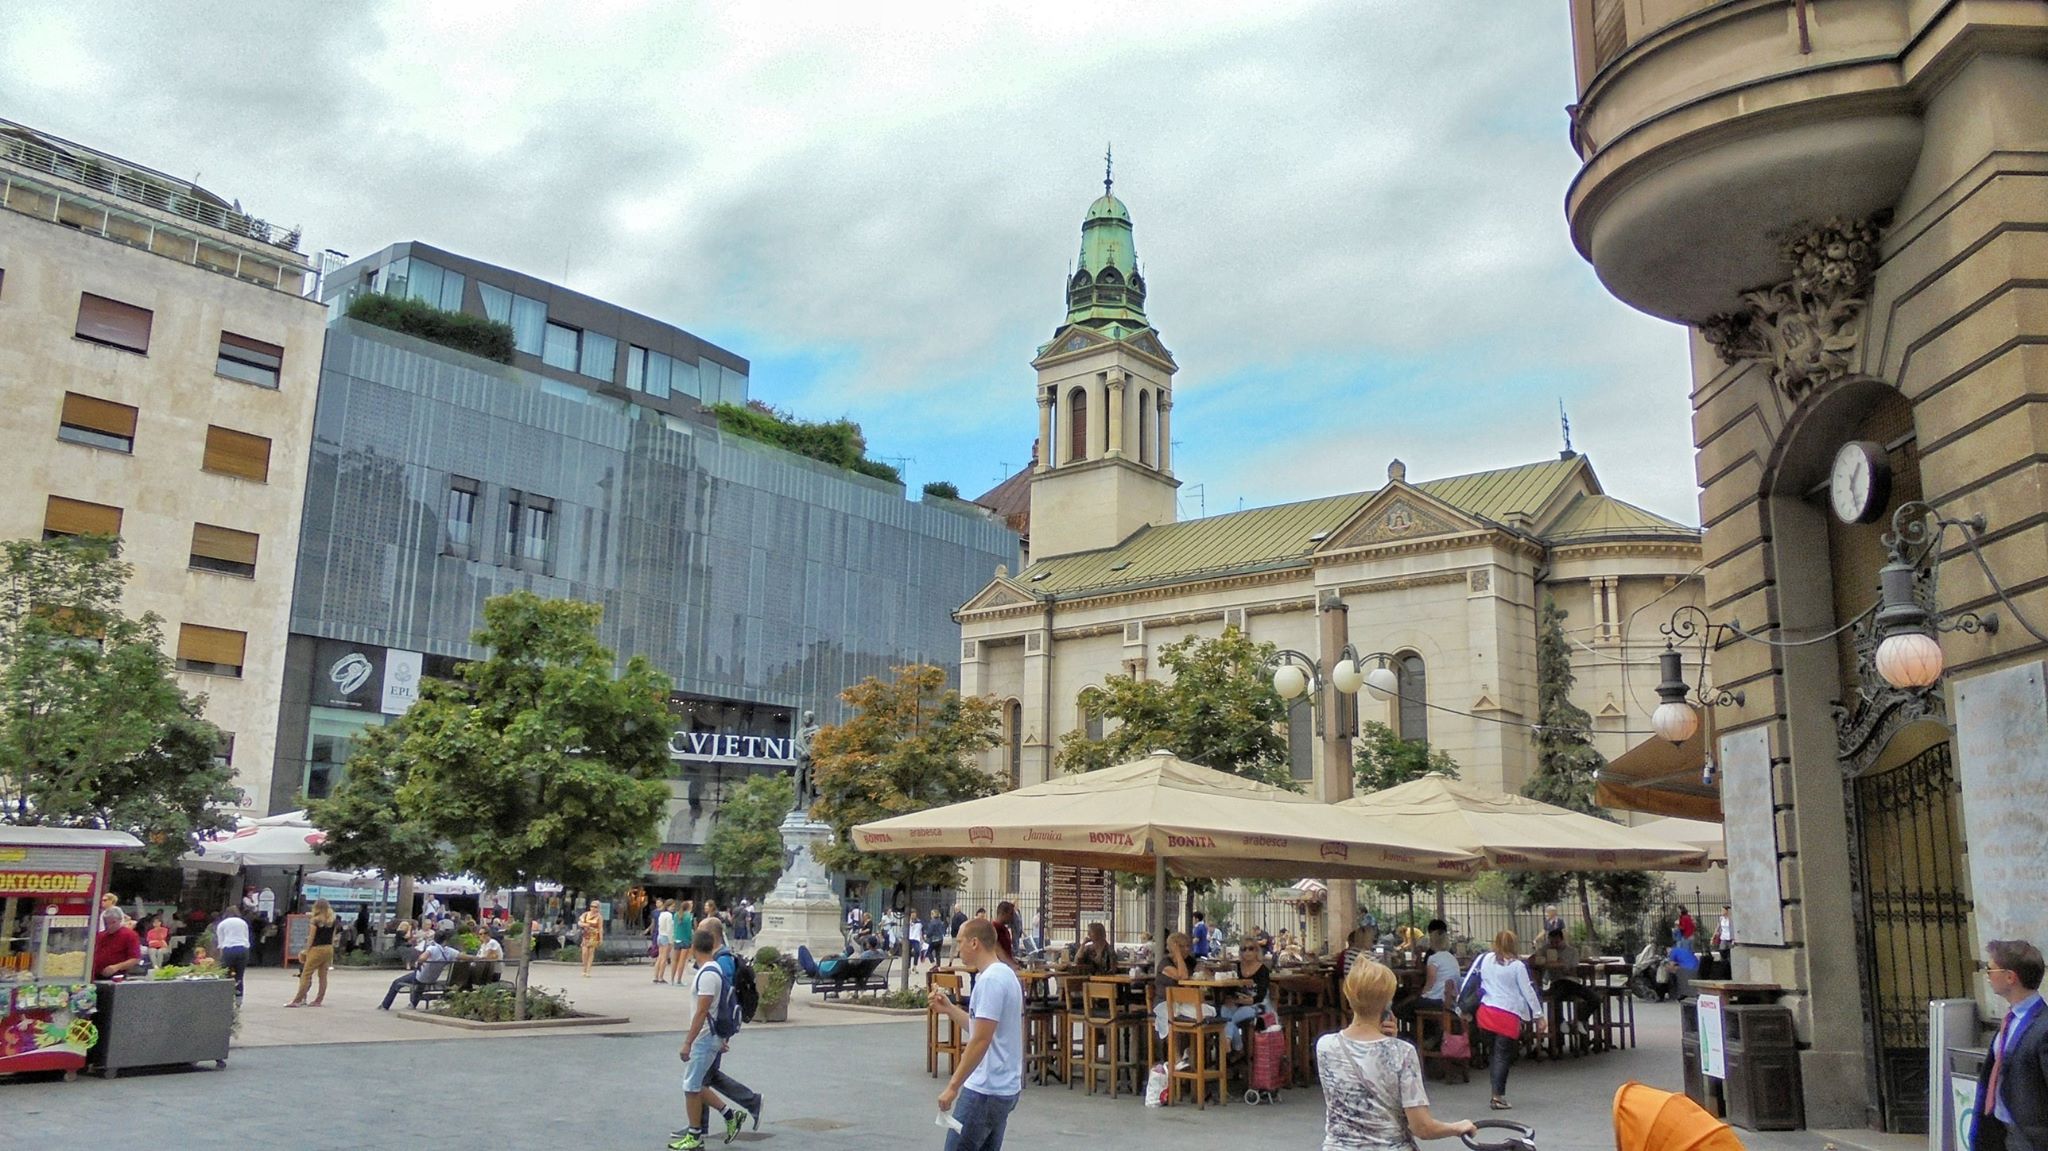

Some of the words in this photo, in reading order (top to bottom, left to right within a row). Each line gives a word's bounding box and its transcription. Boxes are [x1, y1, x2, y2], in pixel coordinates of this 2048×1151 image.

[390, 685, 413, 698] EPL
[667, 731, 797, 763] CVJETNI
[1089, 832, 1134, 846] BONITA
[1168, 835, 1216, 848] BONITA
[1242, 835, 1288, 848] arabesca
